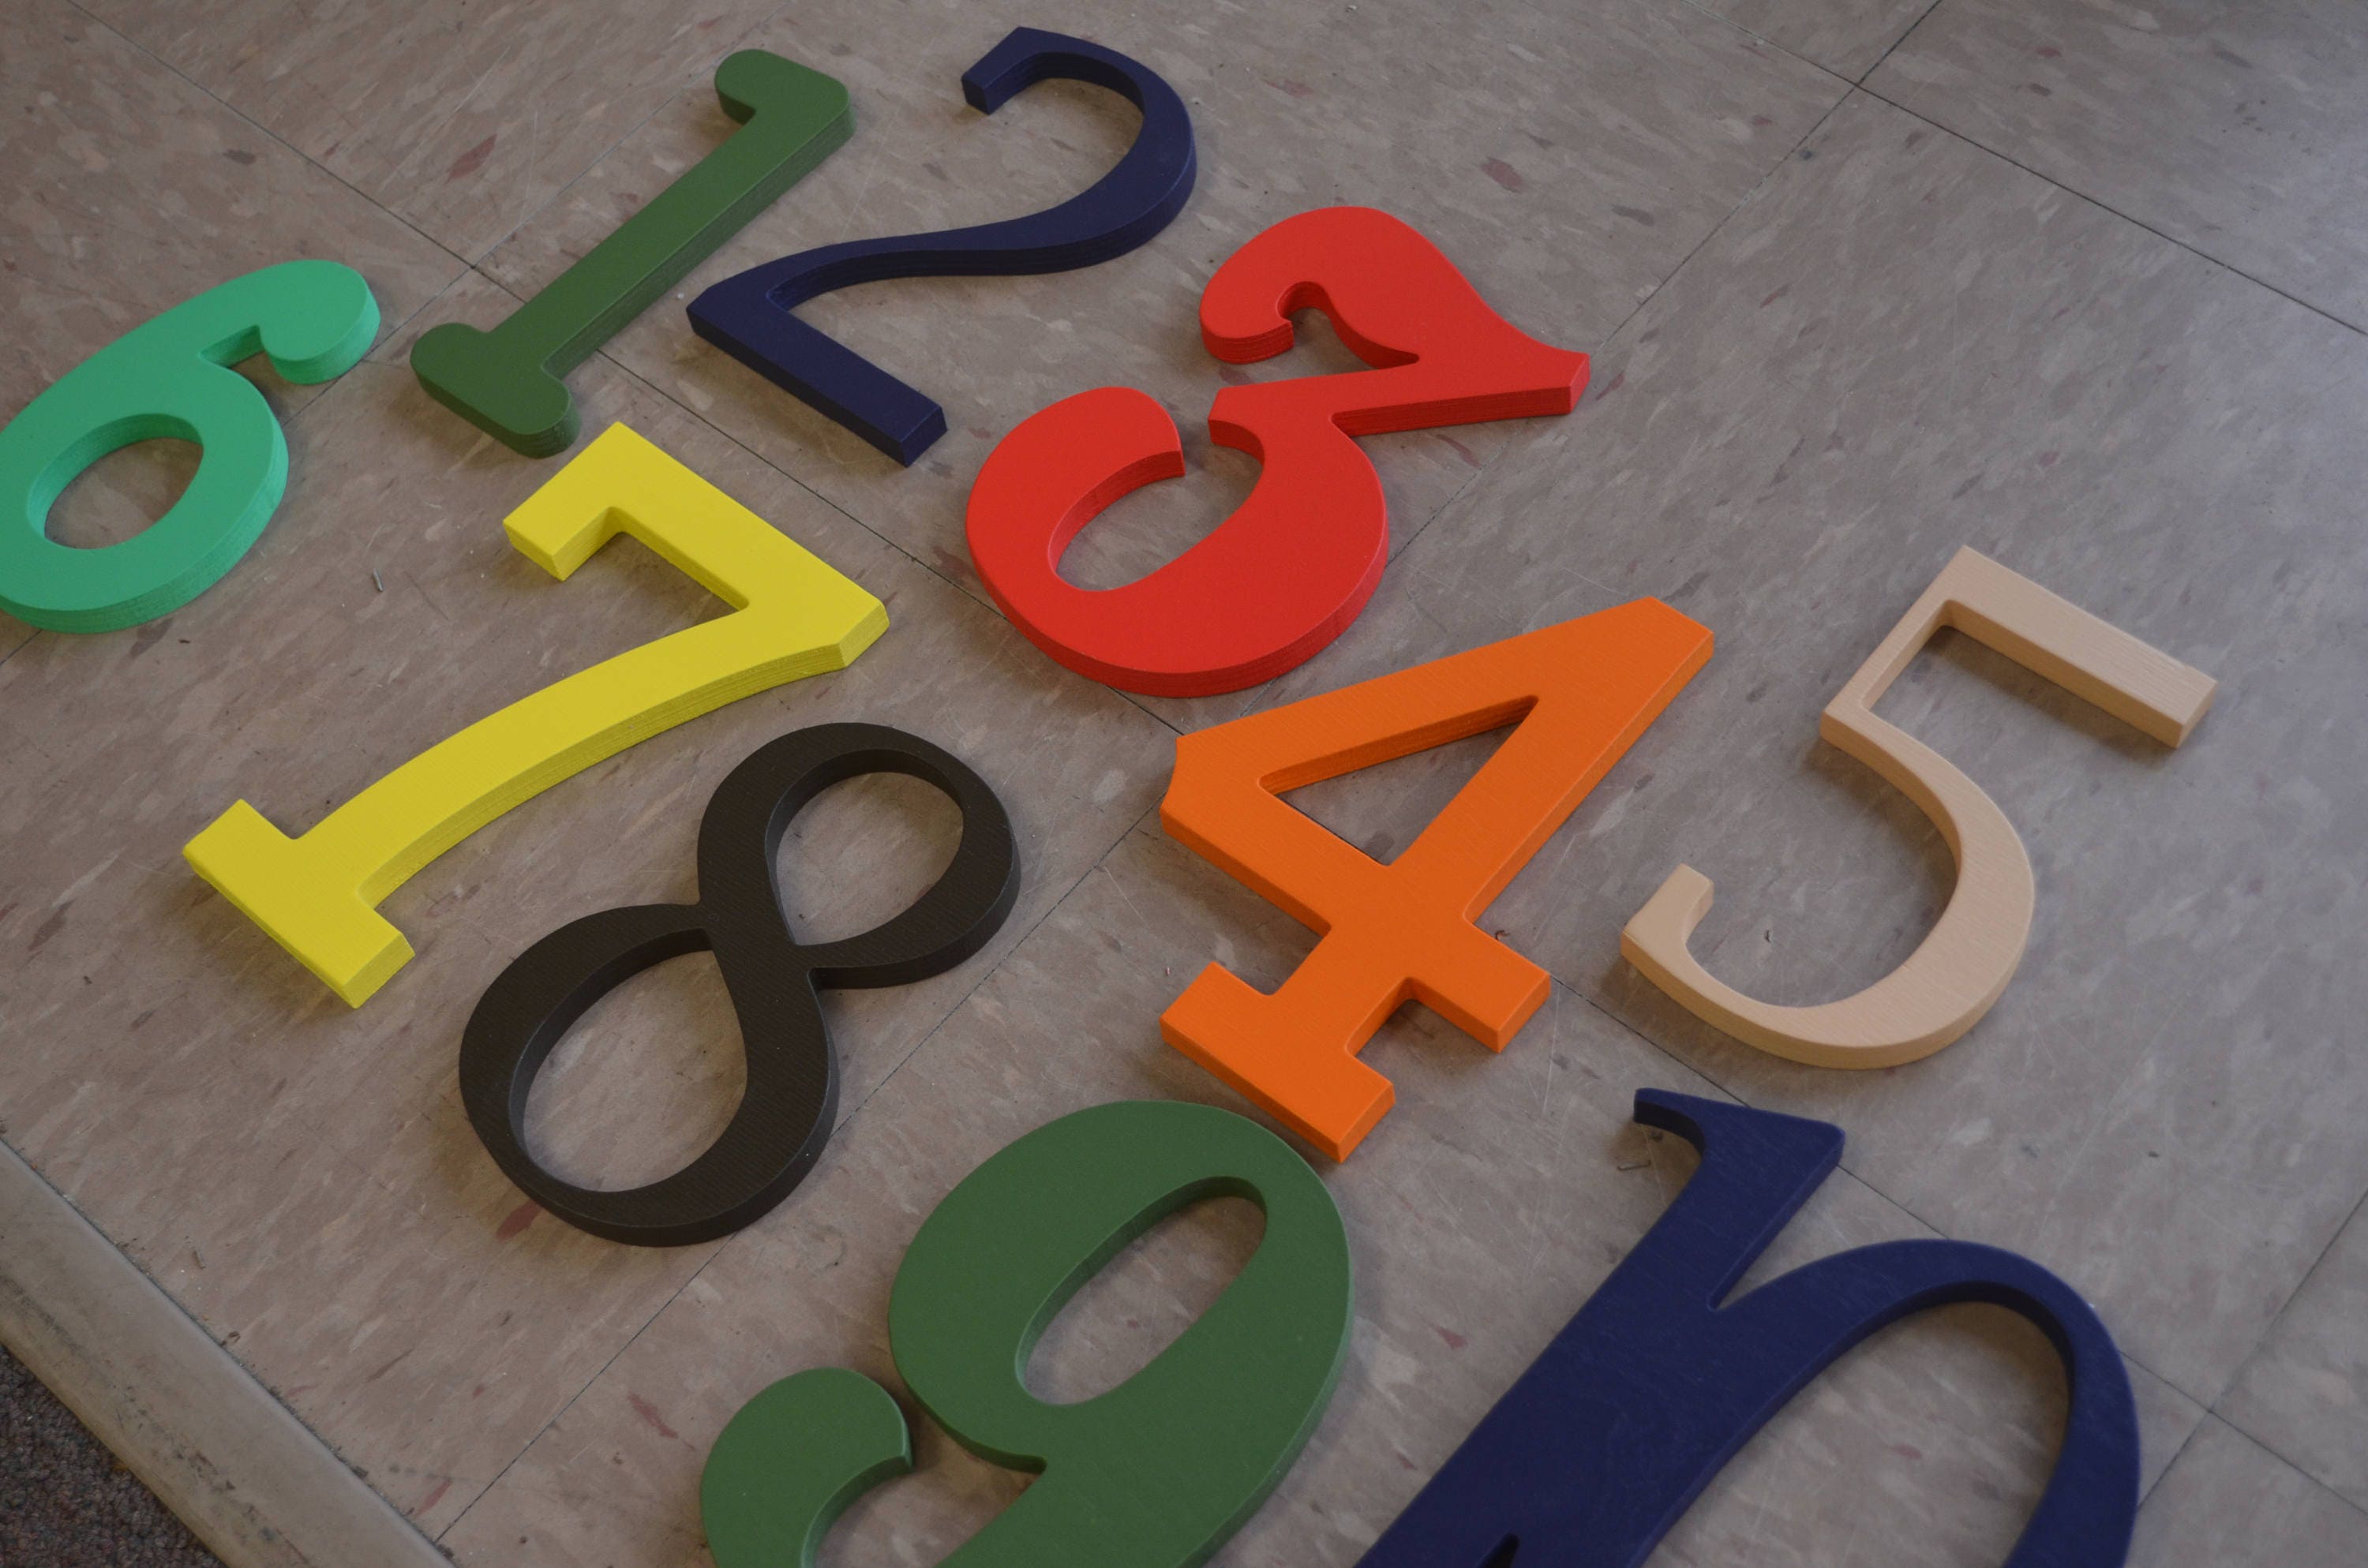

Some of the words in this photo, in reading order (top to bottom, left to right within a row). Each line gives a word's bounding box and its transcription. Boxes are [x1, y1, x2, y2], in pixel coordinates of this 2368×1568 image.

[0, 260, 380, 631] 6
[412, 49, 852, 455] 1
[689, 27, 1195, 464] 2
[967, 207, 1589, 698] 3
[183, 423, 890, 1009] 7
[1161, 597, 1714, 1162] 4
[1621, 546, 2216, 1068] 5
[459, 722, 1020, 1247] 8
[700, 1099, 1351, 1568] 9
